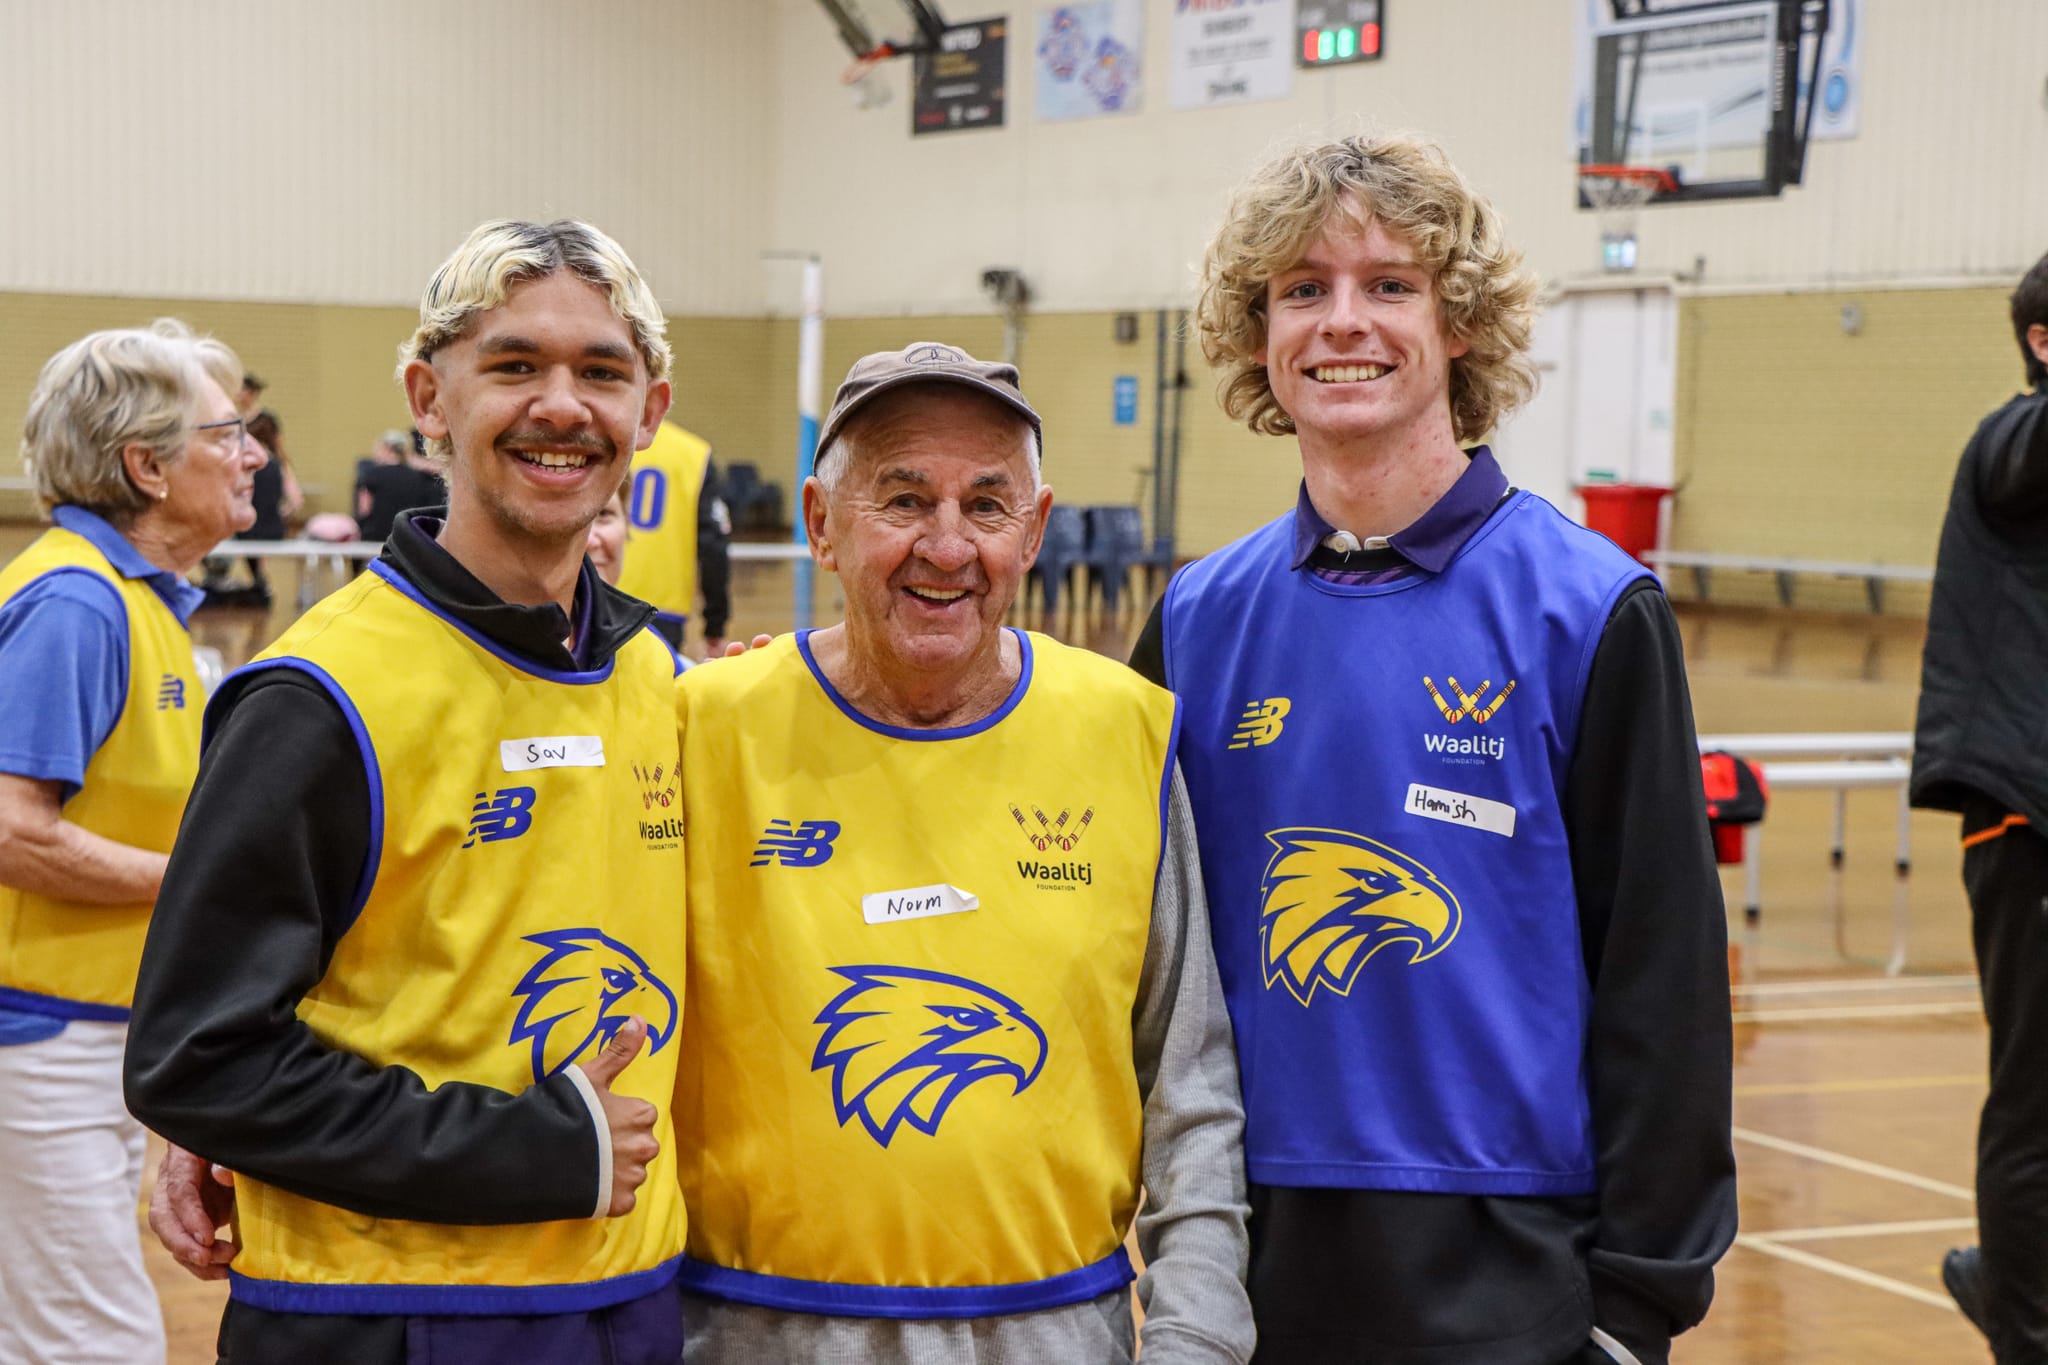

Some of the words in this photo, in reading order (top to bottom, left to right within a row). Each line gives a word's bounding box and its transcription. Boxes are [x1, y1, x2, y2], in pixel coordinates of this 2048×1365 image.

[527, 744, 566, 763] Sav
[1424, 733, 1505, 760] Waalitj
[1442, 757, 1485, 765] FOUNDATION
[462, 786, 537, 849] NB
[1415, 790, 1477, 822] Hamish
[639, 819, 684, 840] Waalit
[750, 819, 842, 868] NB
[1017, 860, 1092, 885] Waalitj
[1036, 883, 1076, 891] FOUNDATION
[887, 895, 942, 915] Norm
